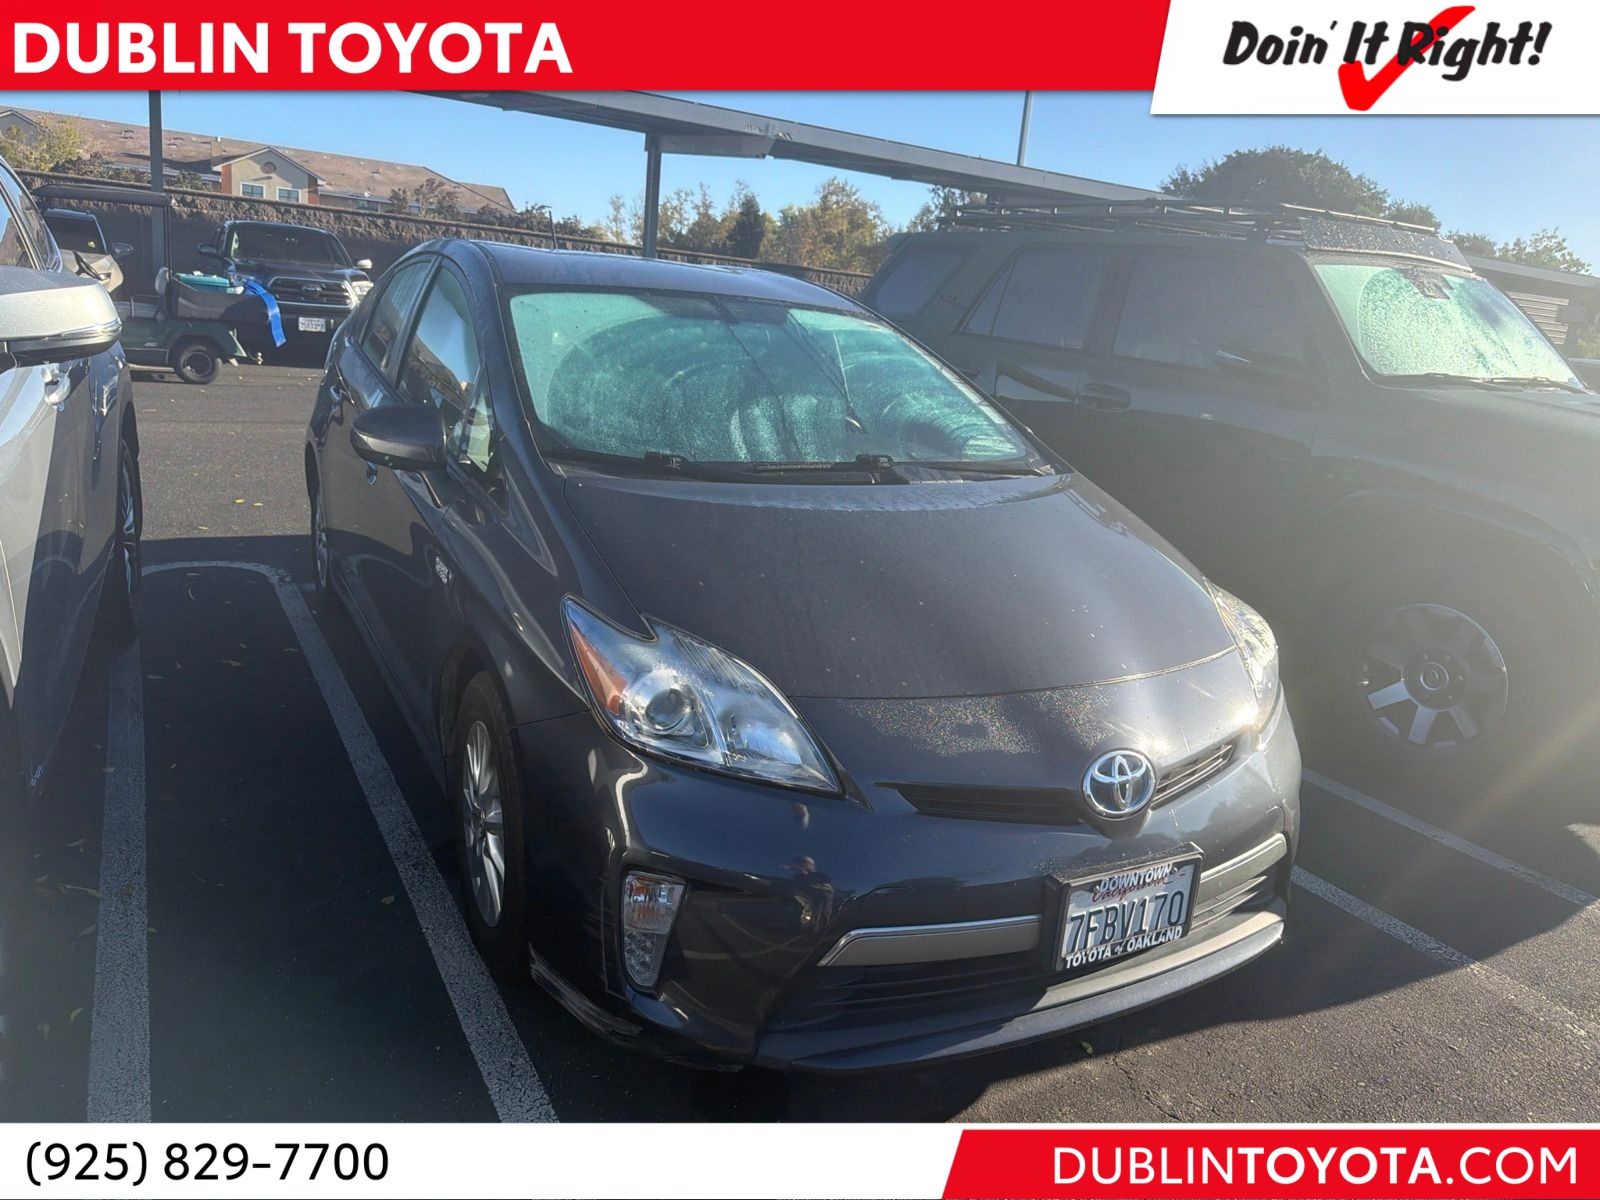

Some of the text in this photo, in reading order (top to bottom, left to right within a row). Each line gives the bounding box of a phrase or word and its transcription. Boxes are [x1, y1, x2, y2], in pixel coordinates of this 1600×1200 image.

[1100, 862, 1173, 893] DOWNTOWN
[1070, 890, 1184, 953] 7FBV170
[1066, 944, 1111, 969] TOYOTA
[1127, 925, 1183, 952] OAKLAND
